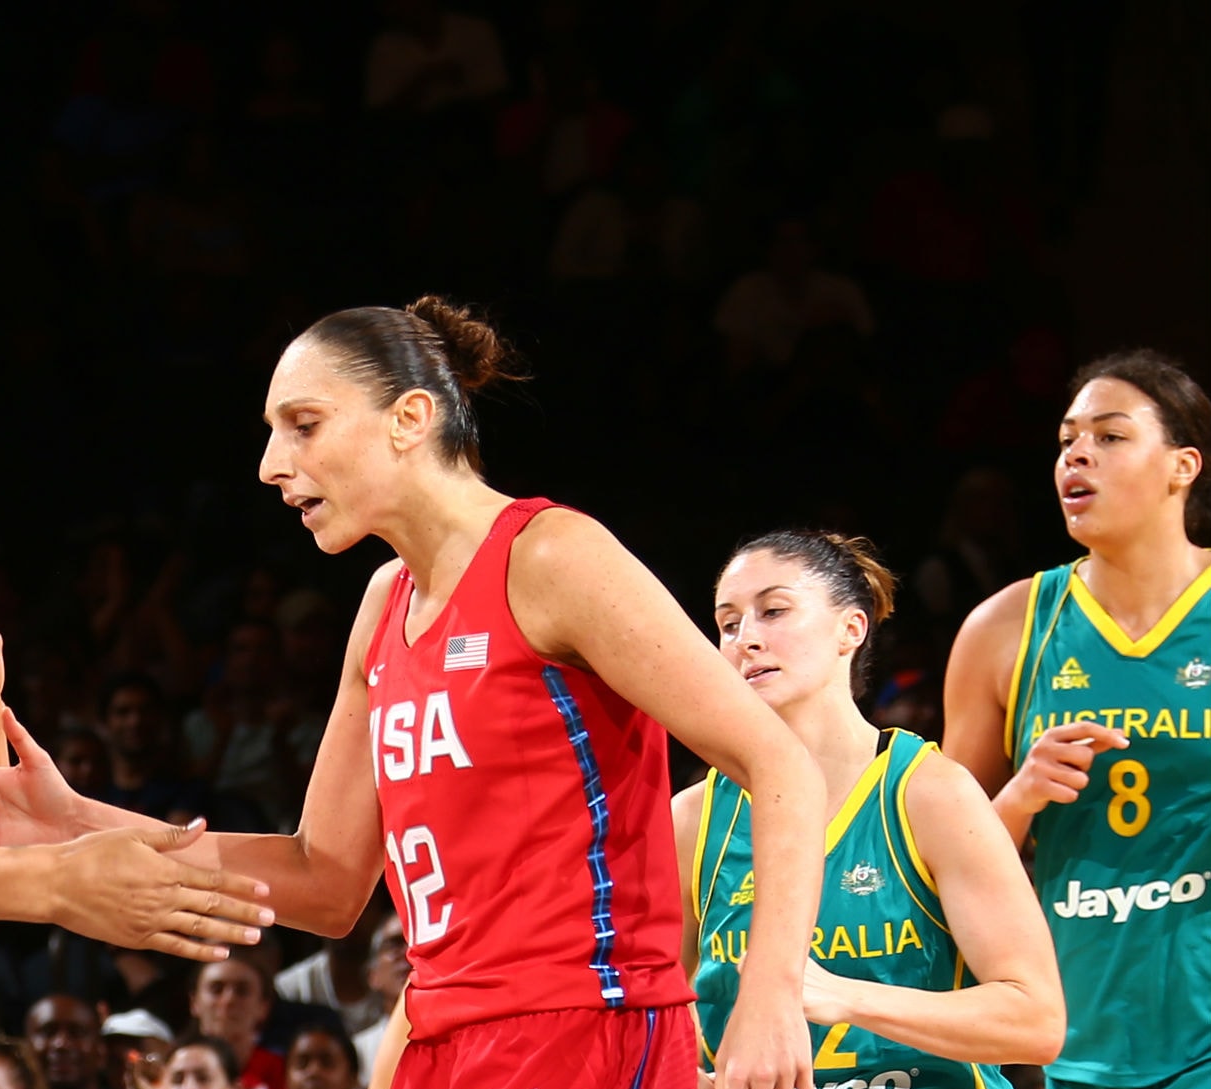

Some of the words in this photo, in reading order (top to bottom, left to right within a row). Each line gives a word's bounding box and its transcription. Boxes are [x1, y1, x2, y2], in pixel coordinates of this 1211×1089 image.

[1051, 676, 1091, 691] PEAK
[1030, 708, 1211, 742] ATRALI
[1107, 759, 1151, 837] 8
[386, 825, 453, 949] 12
[1053, 872, 1207, 923] Jayco
[711, 919, 923, 964] AURALIA
